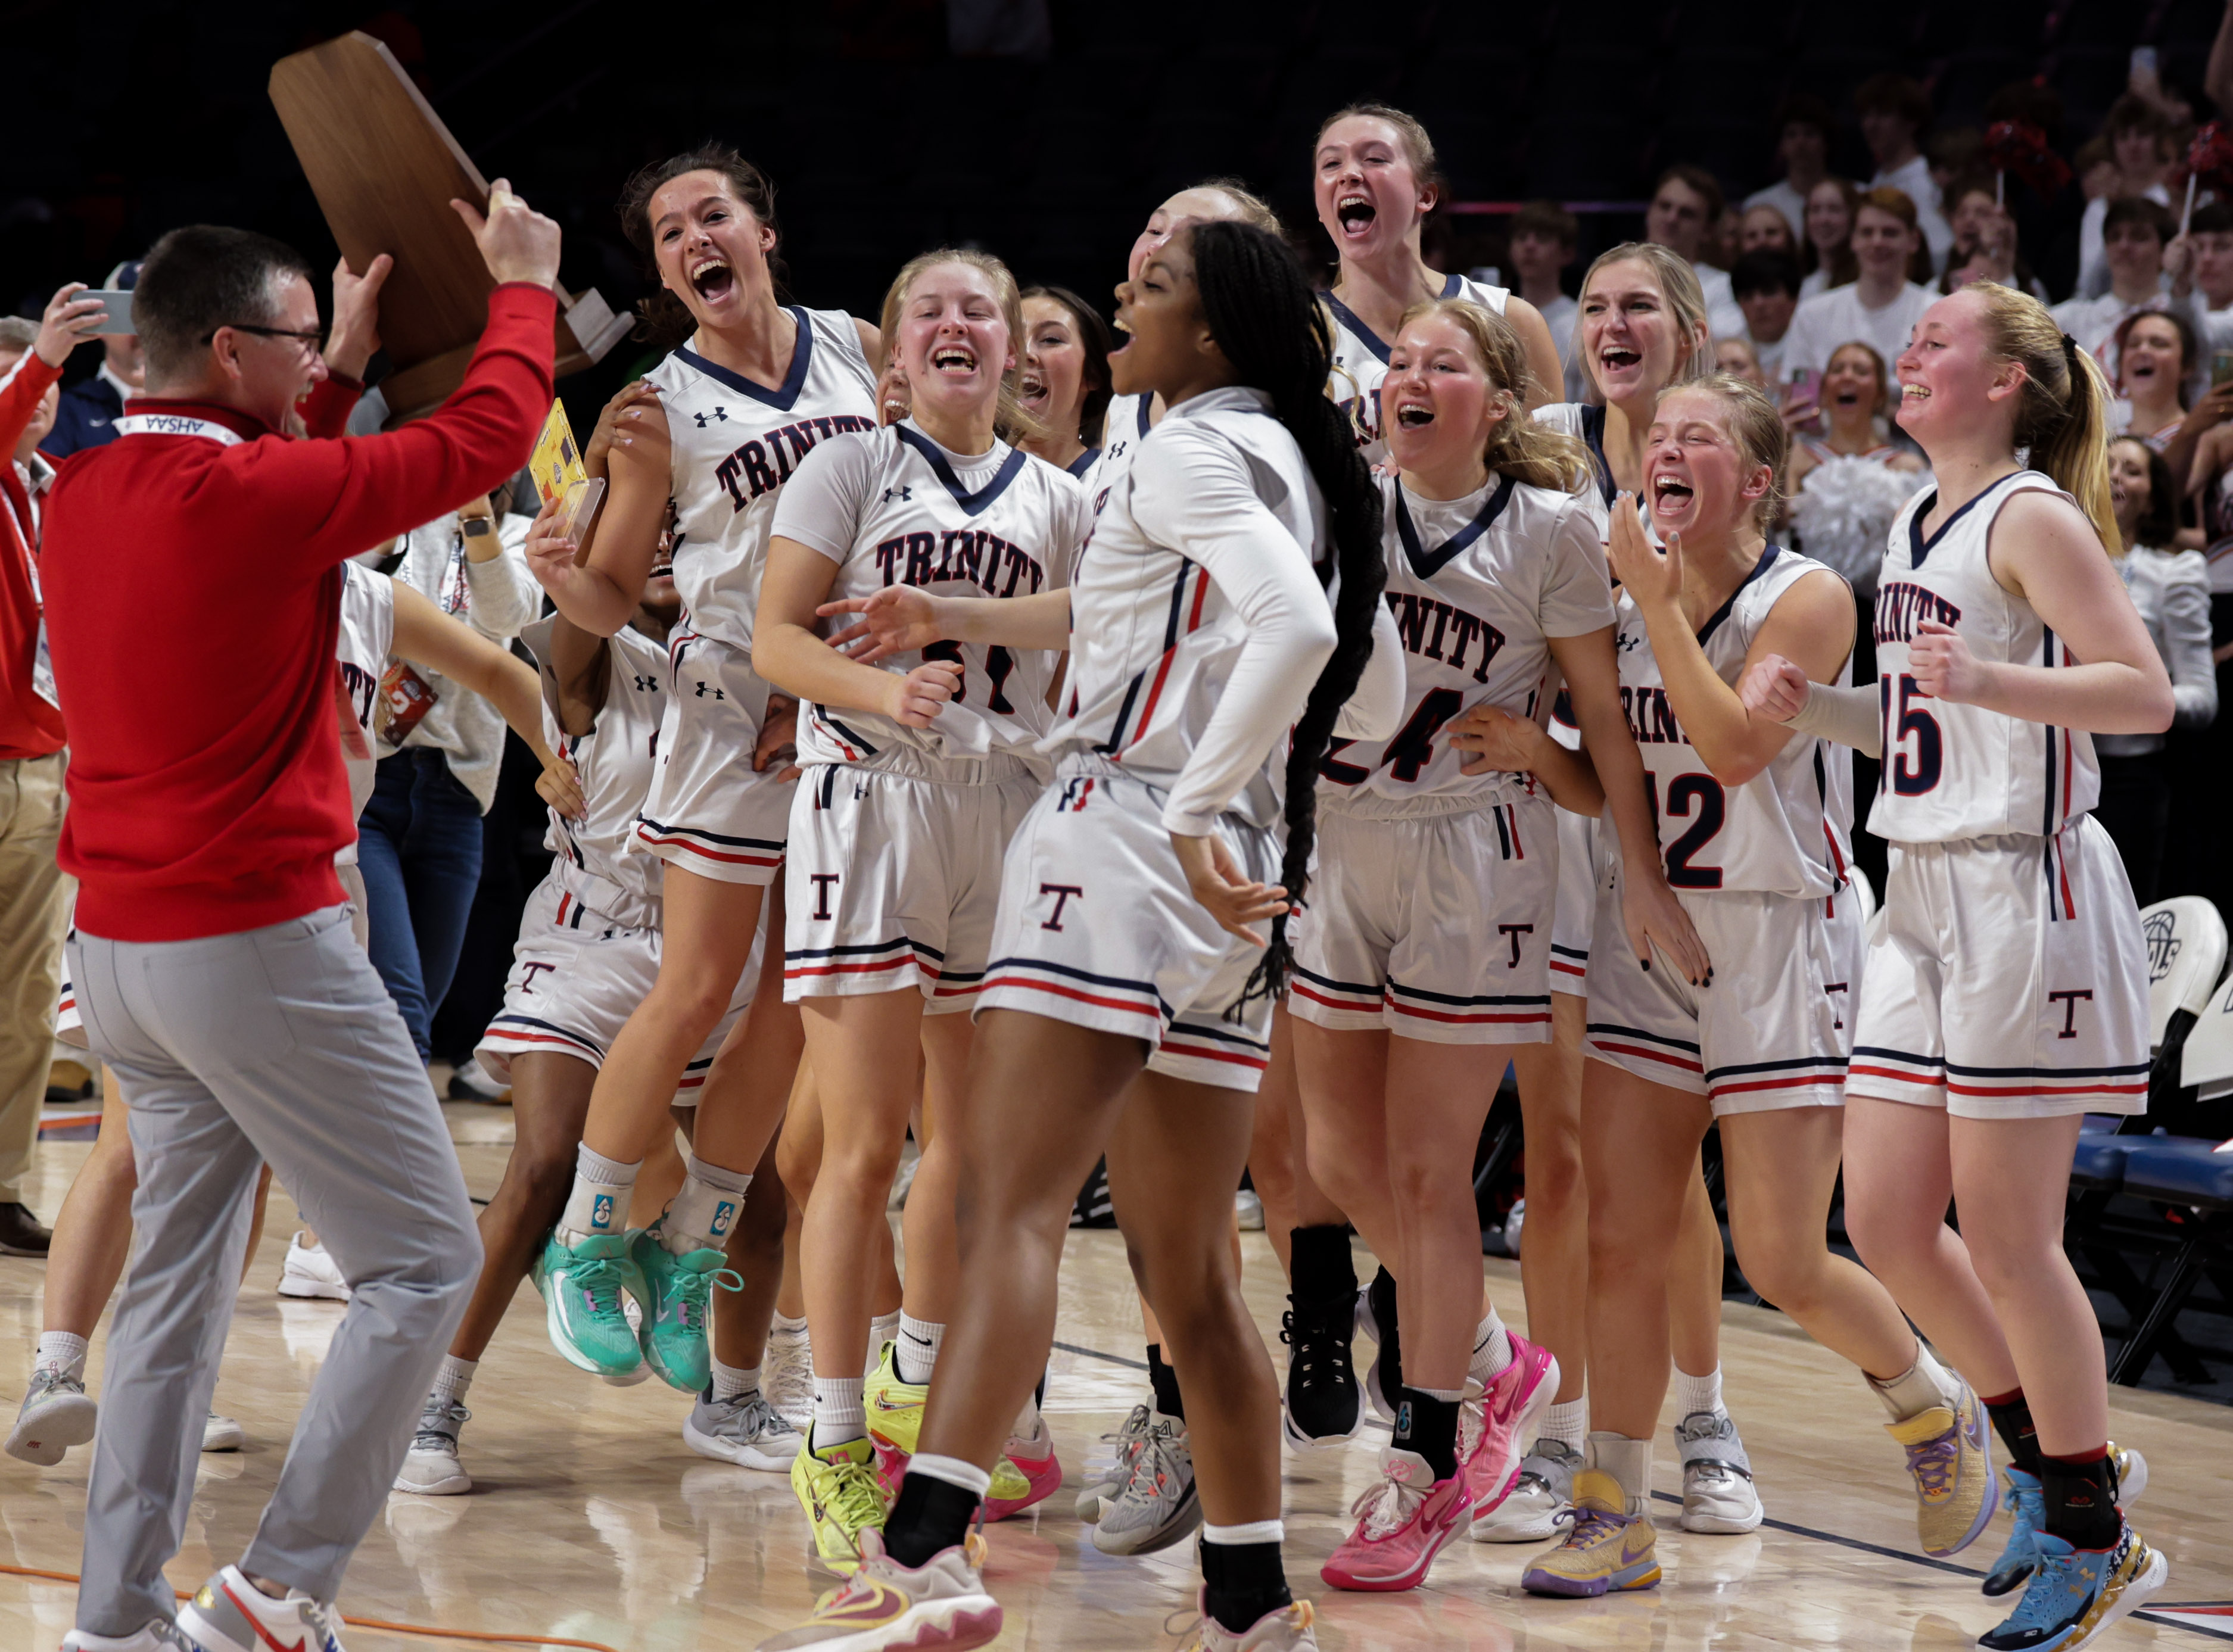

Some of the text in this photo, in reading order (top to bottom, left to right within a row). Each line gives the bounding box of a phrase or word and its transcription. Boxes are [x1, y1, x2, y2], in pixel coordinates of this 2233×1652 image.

[146, 417, 204, 432] AHSAA
[715, 415, 877, 514] TRIN
[1385, 591, 1505, 684] NITY
[1874, 582, 1961, 647] INITY
[1880, 674, 1943, 797] 15
[811, 874, 839, 920] T
[1040, 883, 1083, 931] T
[1499, 924, 1534, 968] T
[521, 961, 555, 994] T
[2049, 989, 2092, 1038] T
